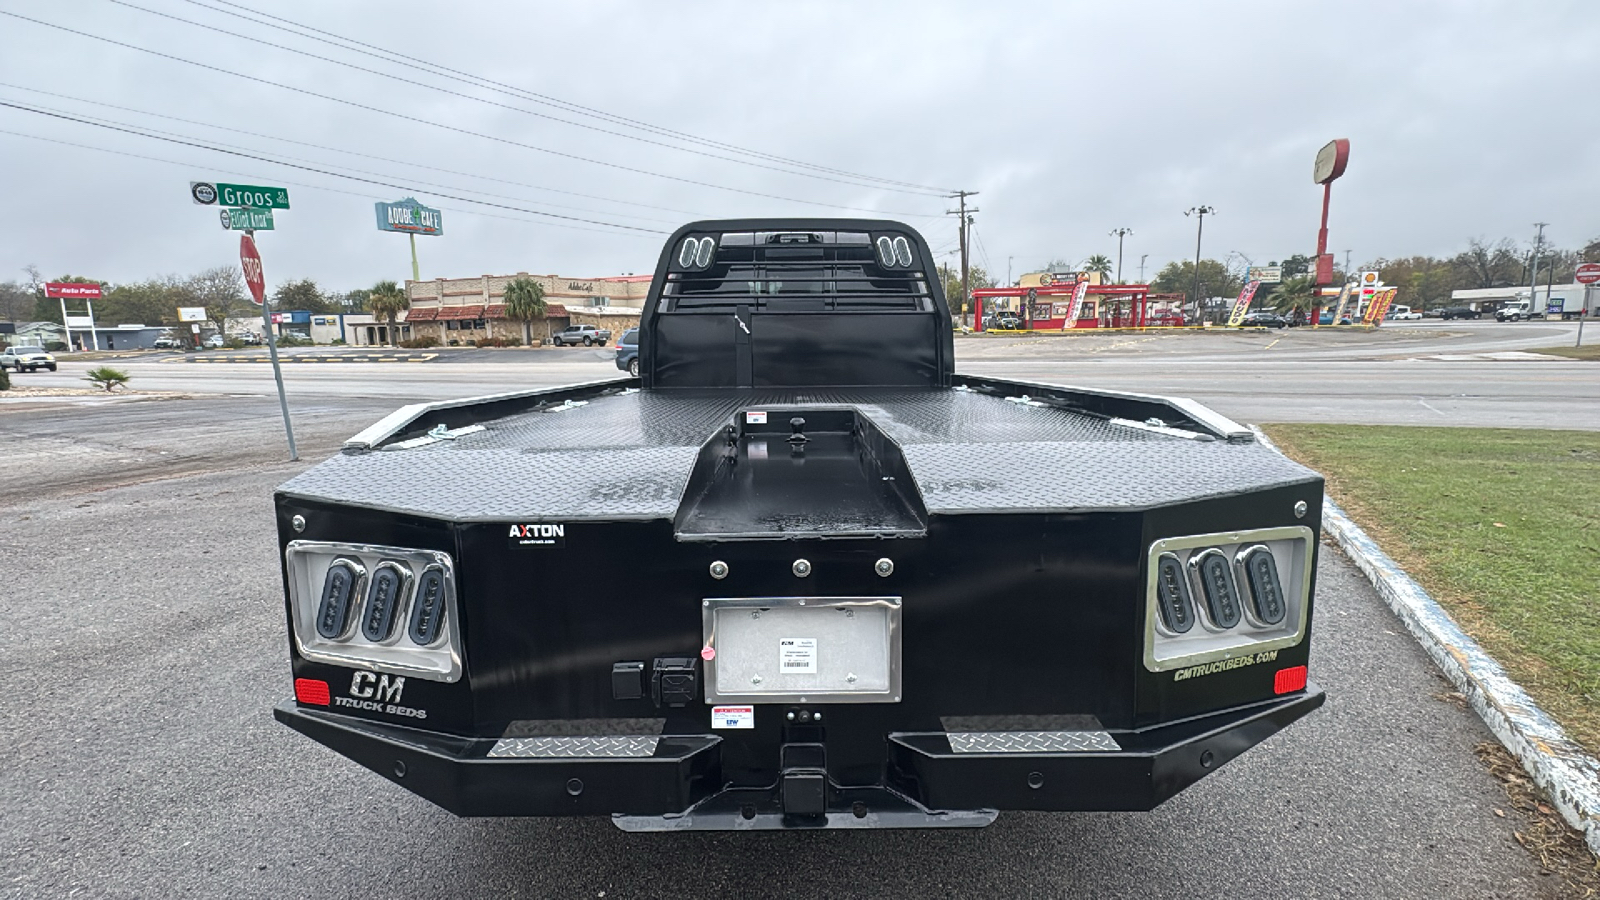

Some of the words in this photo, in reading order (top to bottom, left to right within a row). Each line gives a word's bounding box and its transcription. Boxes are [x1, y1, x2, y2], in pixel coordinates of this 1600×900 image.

[224, 188, 273, 206] Groos
[250, 211, 267, 228] Knox
[388, 206, 413, 224] ADOBE
[420, 210, 439, 229] CAFE
[242, 257, 261, 284] STOP
[509, 524, 564, 537] AXTON
[1173, 650, 1278, 682] CMTRUCKBEDS.COM
[349, 670, 406, 704] CM
[334, 696, 384, 713] TRUCK
[385, 704, 428, 719] BEDS
